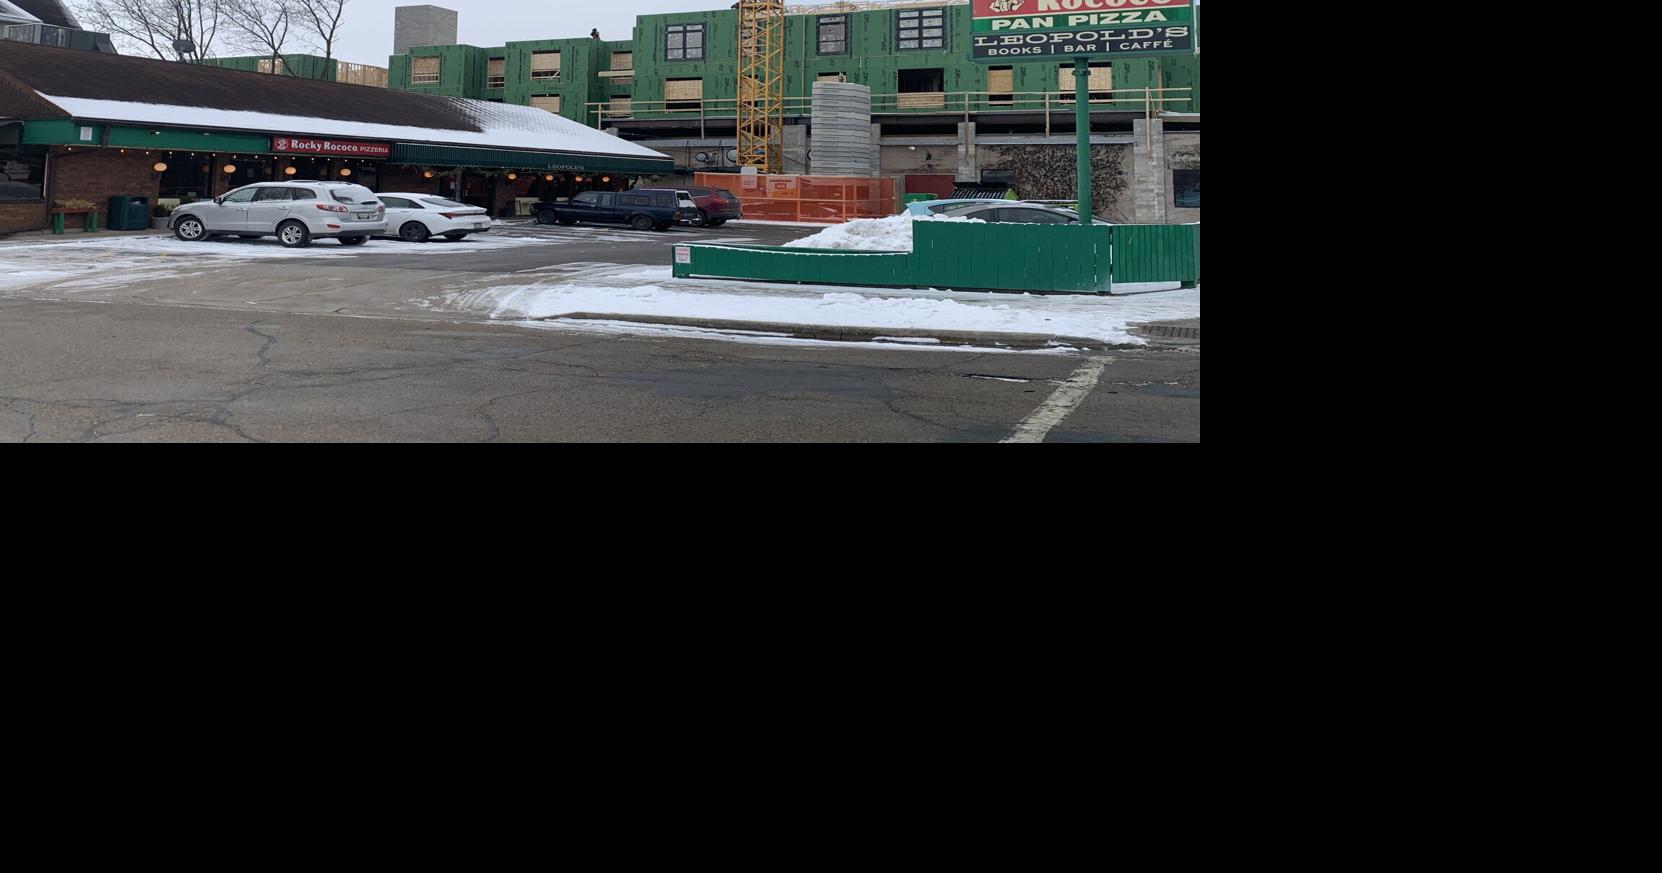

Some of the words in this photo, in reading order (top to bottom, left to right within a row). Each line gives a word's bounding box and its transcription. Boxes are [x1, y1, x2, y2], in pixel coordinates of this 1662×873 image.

[1038, 0, 1170, 11] Roc
[991, 17, 1053, 31] PAN
[1068, 10, 1167, 26] PIZZA
[974, 27, 1188, 46] LEOPOLD'S
[988, 46, 1042, 56] BOOKS
[1064, 44, 1097, 53] BAR
[1119, 38, 1173, 50] CAFFÉ
[291, 139, 321, 151] Rocky
[324, 141, 358, 152] Rococo
